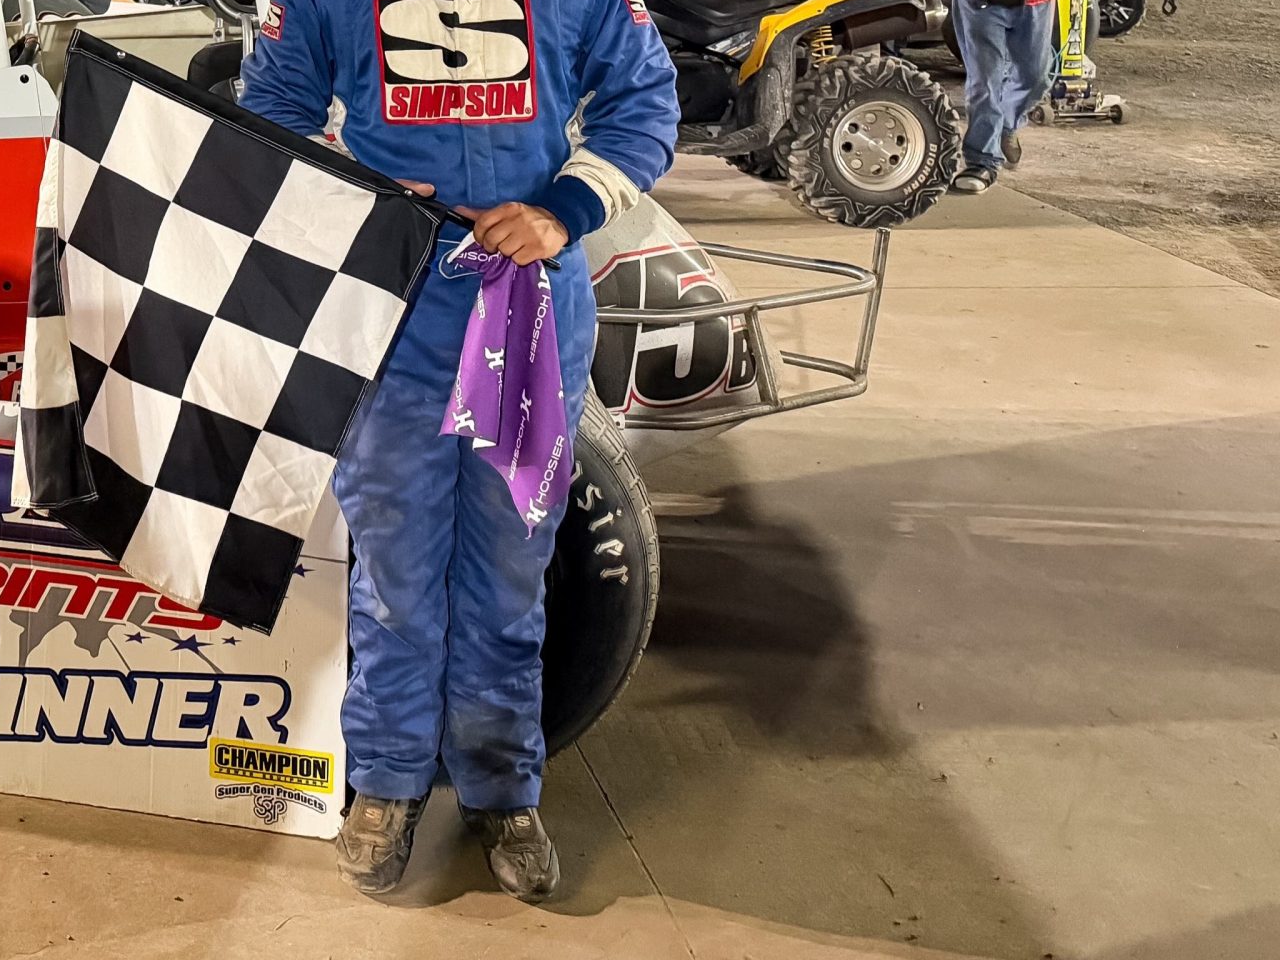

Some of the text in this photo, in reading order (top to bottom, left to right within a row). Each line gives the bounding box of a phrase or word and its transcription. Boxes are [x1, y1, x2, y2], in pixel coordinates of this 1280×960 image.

[389, 82, 527, 119] SIMPSON
[903, 142, 938, 196] BIGHORN
[529, 293, 552, 364] HOOSIER
[508, 415, 527, 482] HOOSIER
[535, 434, 566, 505] HOOSIER
[216, 745, 328, 781] CHAMPION
[216, 784, 326, 813] Super Gen Products
